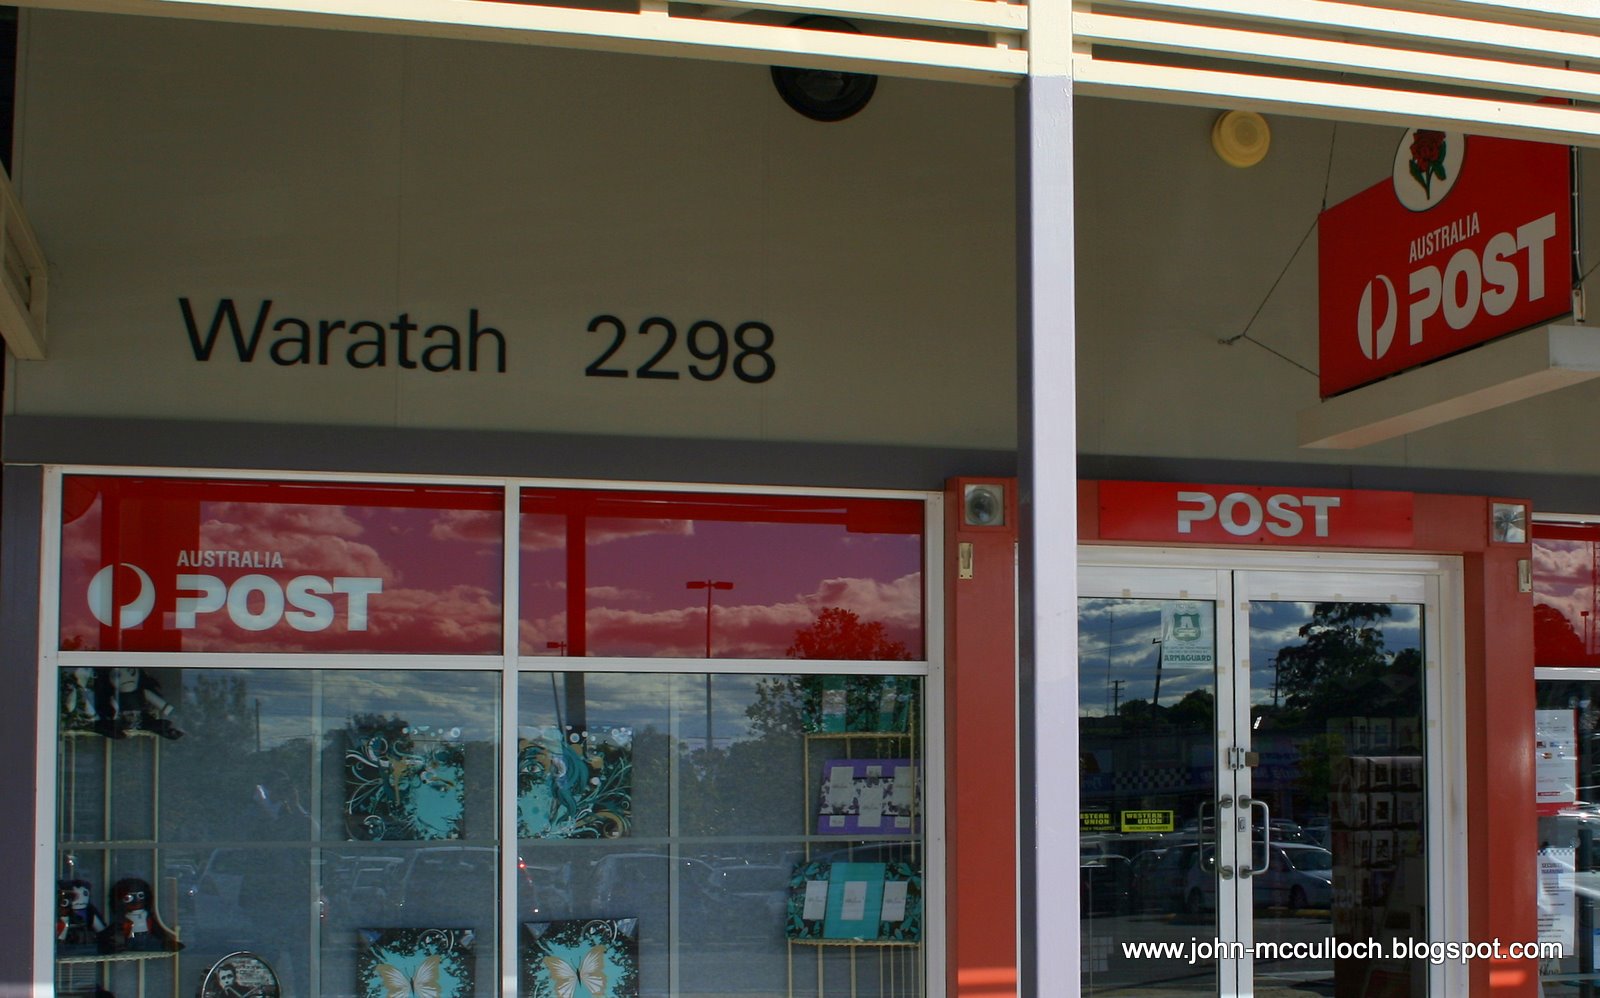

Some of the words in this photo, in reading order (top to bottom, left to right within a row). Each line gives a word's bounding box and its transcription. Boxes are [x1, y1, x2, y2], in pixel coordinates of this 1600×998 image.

[1409, 211, 1480, 263] AUSTRALIA
[1409, 212, 1556, 346] POST
[178, 297, 507, 373] Waratah
[585, 314, 777, 384] 2298
[1177, 491, 1340, 537] POST
[176, 550, 284, 569] AUSTRALIA
[175, 574, 383, 632] POST
[1163, 654, 1212, 662] ARMAGUARD
